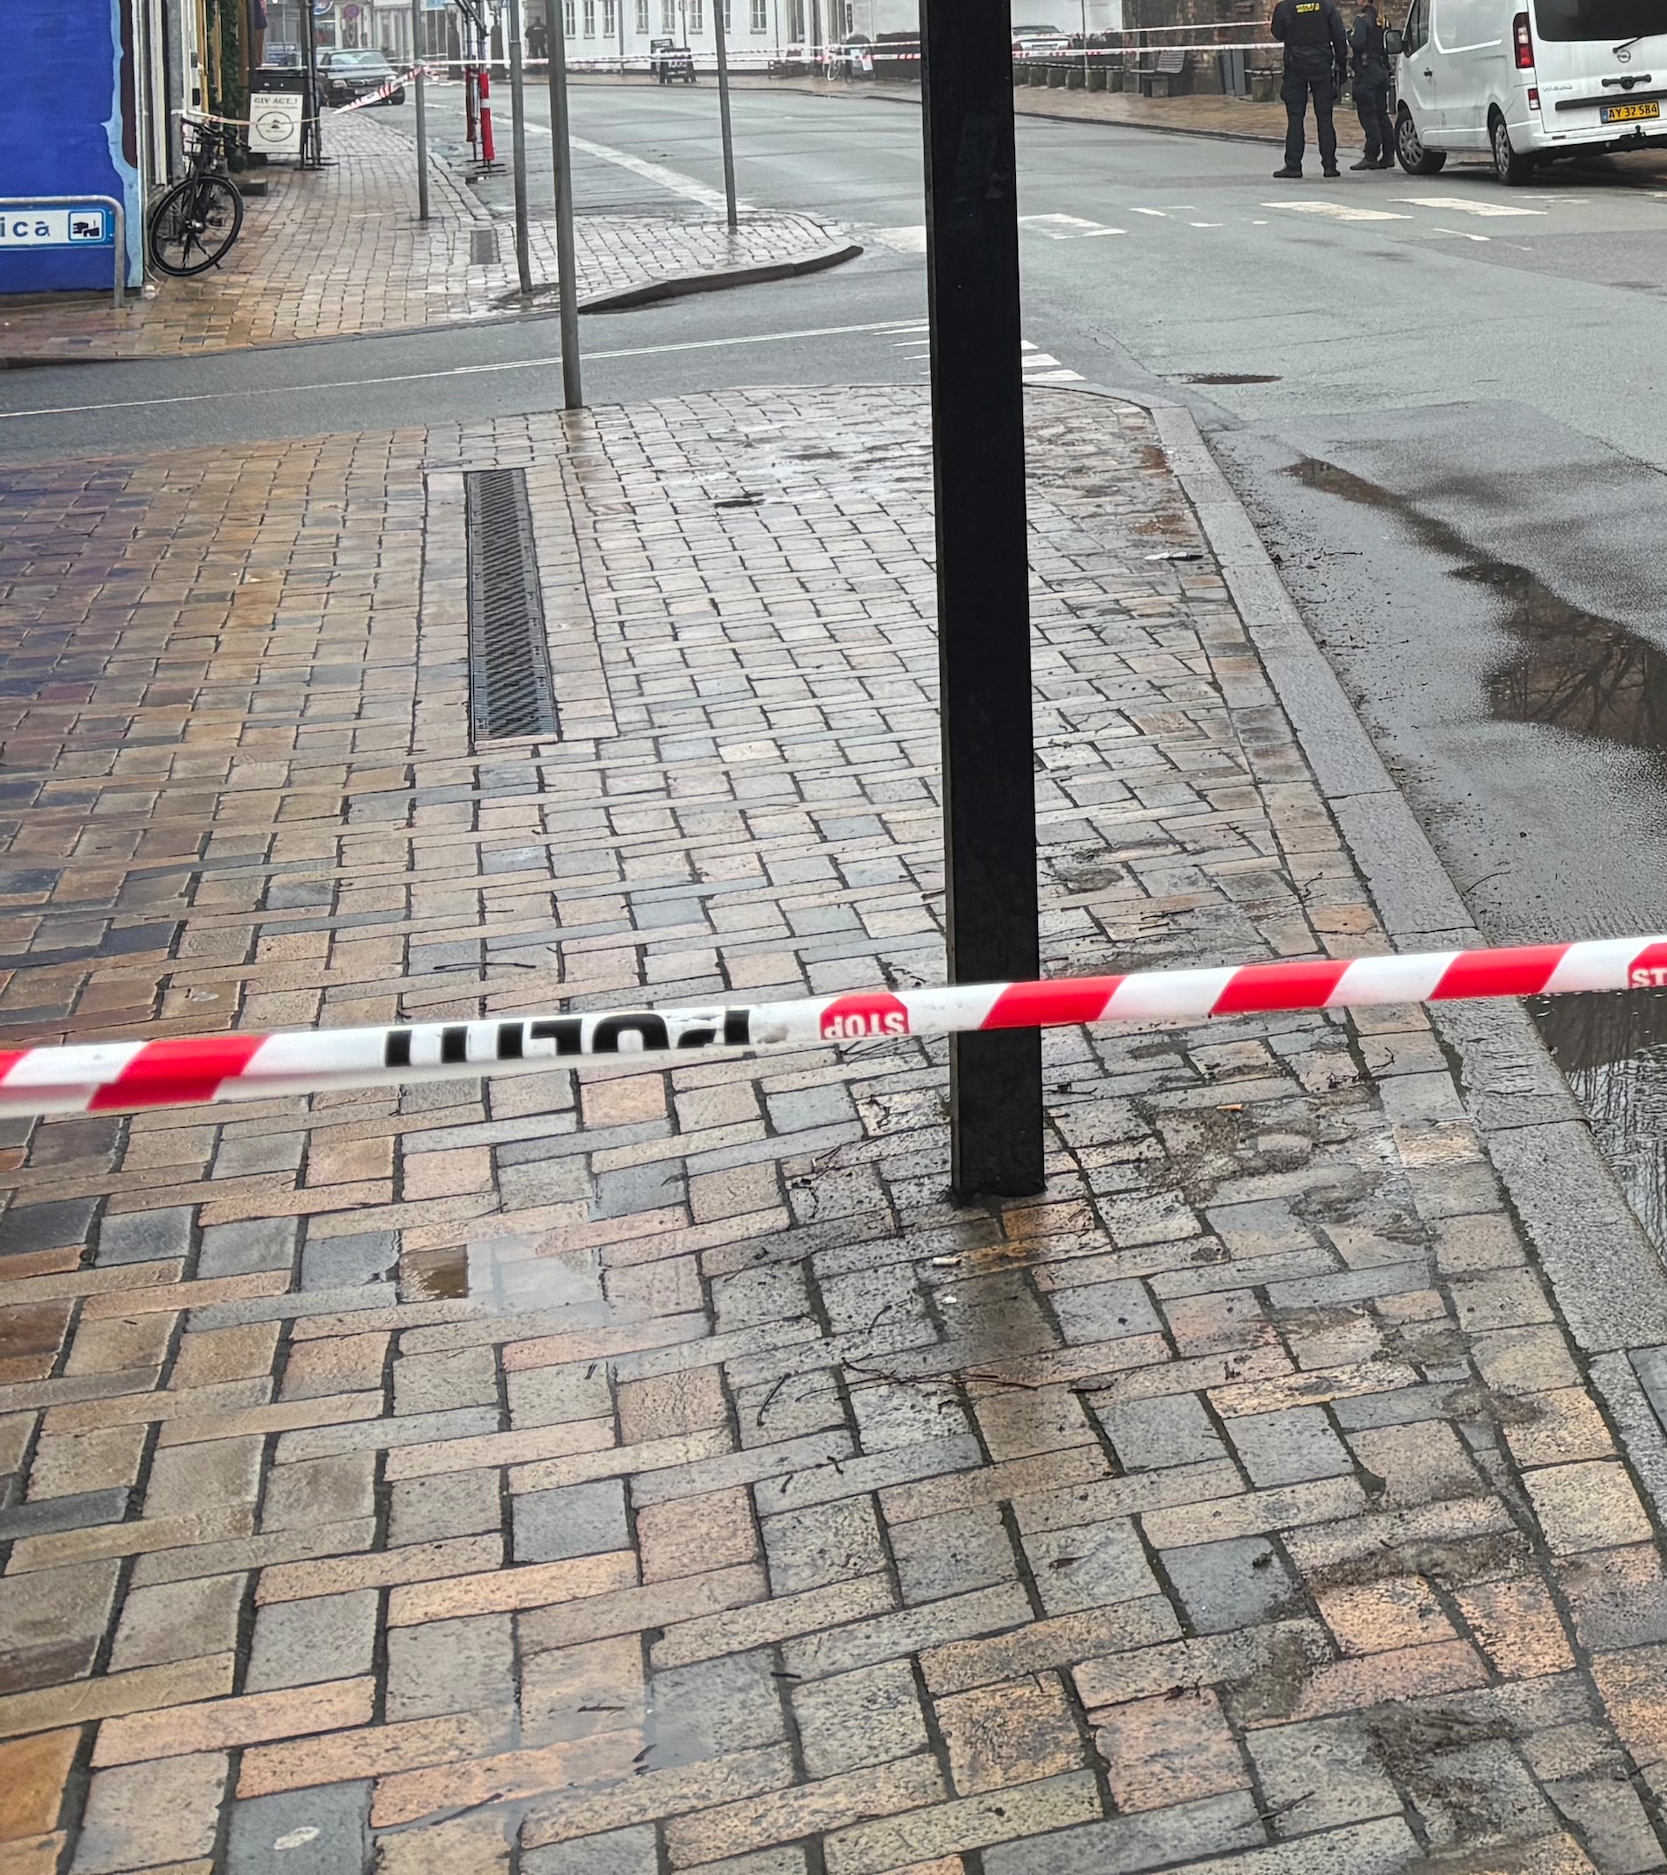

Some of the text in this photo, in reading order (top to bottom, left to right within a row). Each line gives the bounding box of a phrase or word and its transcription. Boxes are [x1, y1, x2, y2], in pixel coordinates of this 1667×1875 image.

[1609, 108, 1621, 118] AY
[1624, 107, 1636, 117] 32
[823, 1010, 908, 1041] STOP
